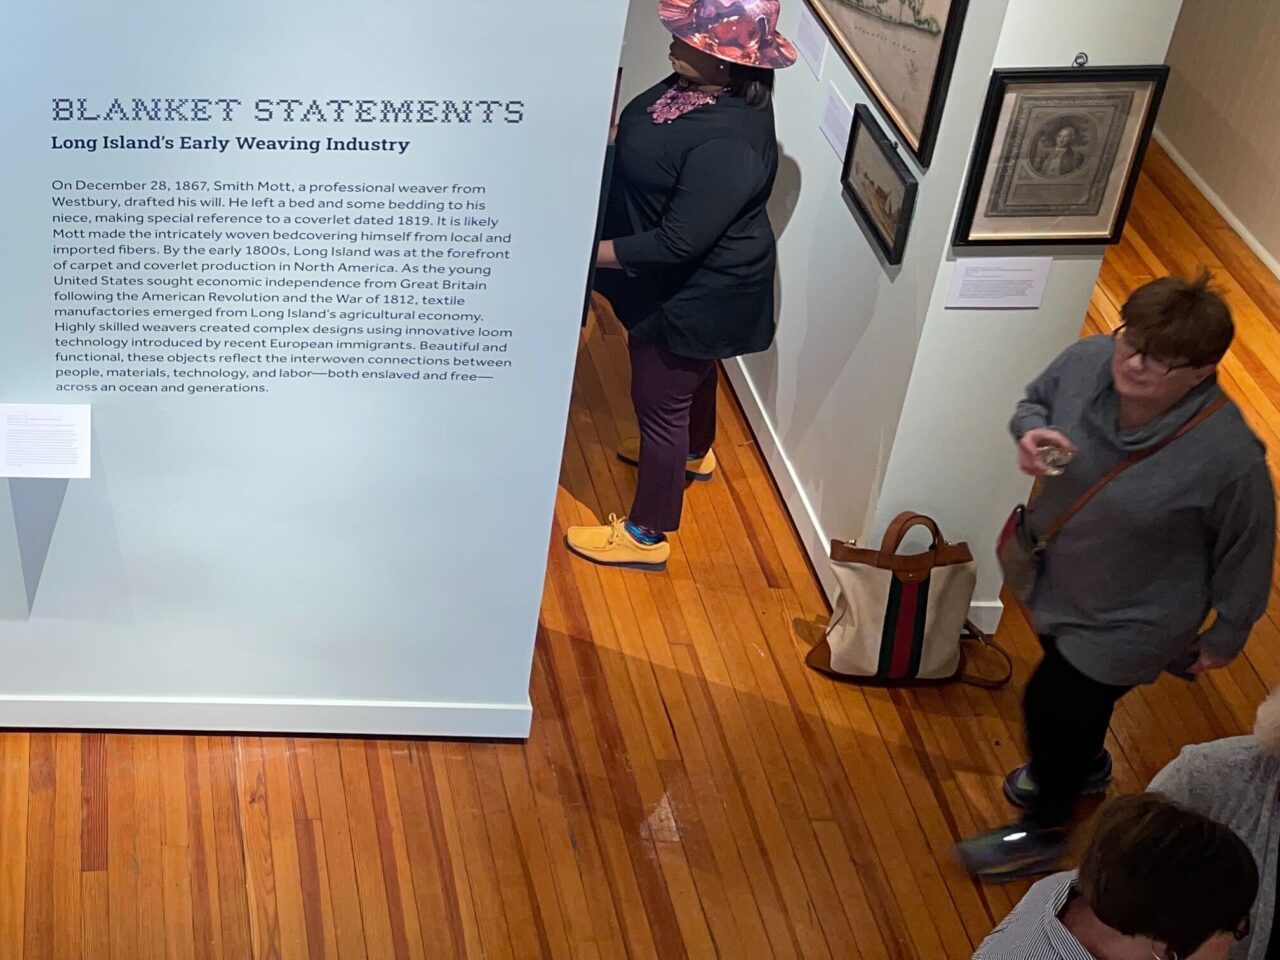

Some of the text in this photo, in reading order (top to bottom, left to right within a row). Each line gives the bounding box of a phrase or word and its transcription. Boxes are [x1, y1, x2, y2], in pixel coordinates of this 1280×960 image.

[52, 98, 524, 123] BLANKET STATEMENTS
[51, 135, 410, 154] Long Island's Early Weaving Industry
[52, 180, 486, 194] On December 28, 1867, Smith Mott, a professional weaver from
[52, 196, 486, 213] Westbury, drafted his will. He left a bed and some bedding to his
[52, 212, 499, 230] niece, making special reference to a coverlet dated 1819. It is likely
[53, 228, 511, 243] Mott made the intricately woven bedcovering himself from local and
[53, 244, 510, 259] imported fibers. By the early 1800s, Long Island was at the forefront
[53, 259, 491, 277] of carpet and coverlet production in North America. As the young
[54, 275, 487, 290] United States sought economic independence from Great Britain
[54, 291, 465, 306] following the American Revolution and the War of 1812, textile
[54, 306, 484, 324] manufactories emerged from Long Island's agricultural economy.
[55, 321, 512, 337] Highly skilled weavers created complex designs using innovative loom
[55, 336, 507, 352] technology introduced by recent European immigrants. Beautiful and
[55, 351, 512, 367] functional, these objects reflect the interwoven connections between
[55, 367, 103, 379] people,
[106, 367, 170, 379] materials,
[173, 368, 249, 380] technology,
[252, 368, 277, 378] and
[361, 370, 420, 380] enslaved
[422, 371, 448, 381] and
[56, 383, 269, 395] across an ocean and generations.
